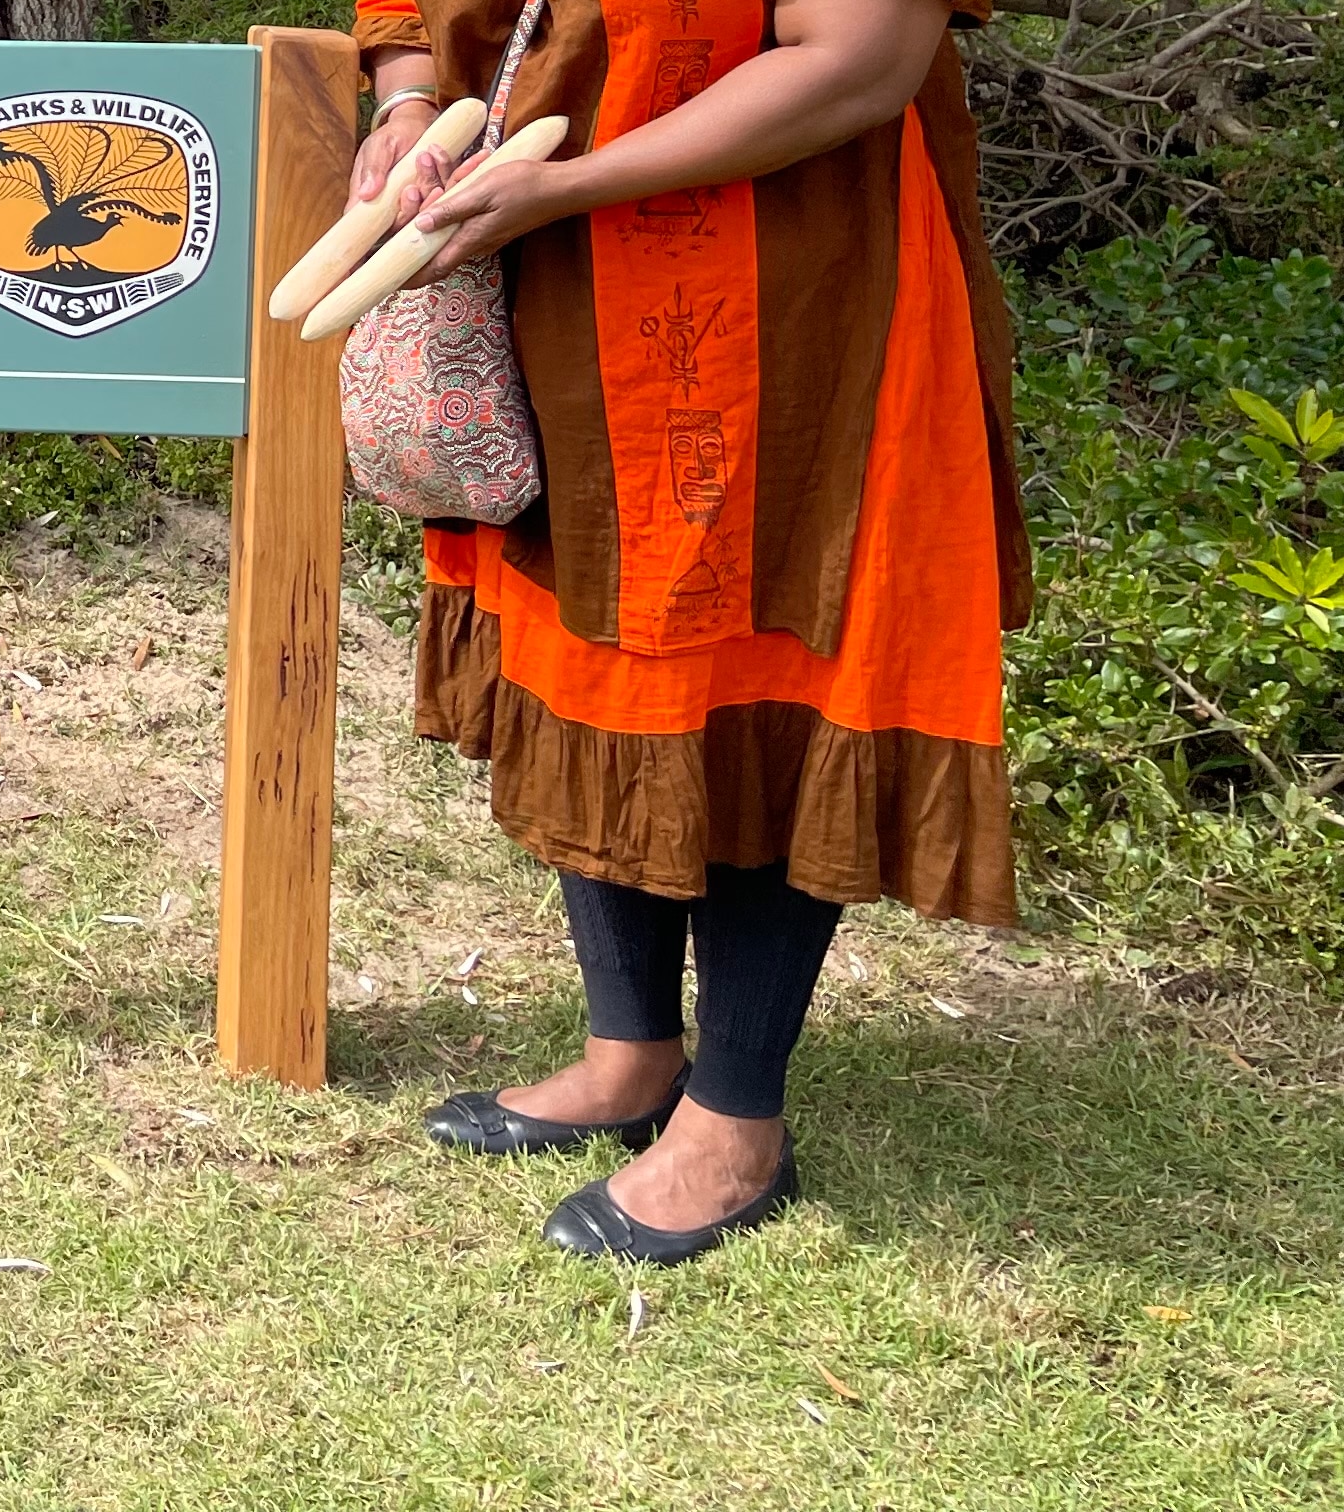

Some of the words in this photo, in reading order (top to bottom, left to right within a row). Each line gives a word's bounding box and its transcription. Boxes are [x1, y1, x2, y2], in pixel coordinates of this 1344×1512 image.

[70, 99, 86, 115] &
[92, 99, 203, 149] WILDLIFE
[184, 152, 212, 261] SERVICE
